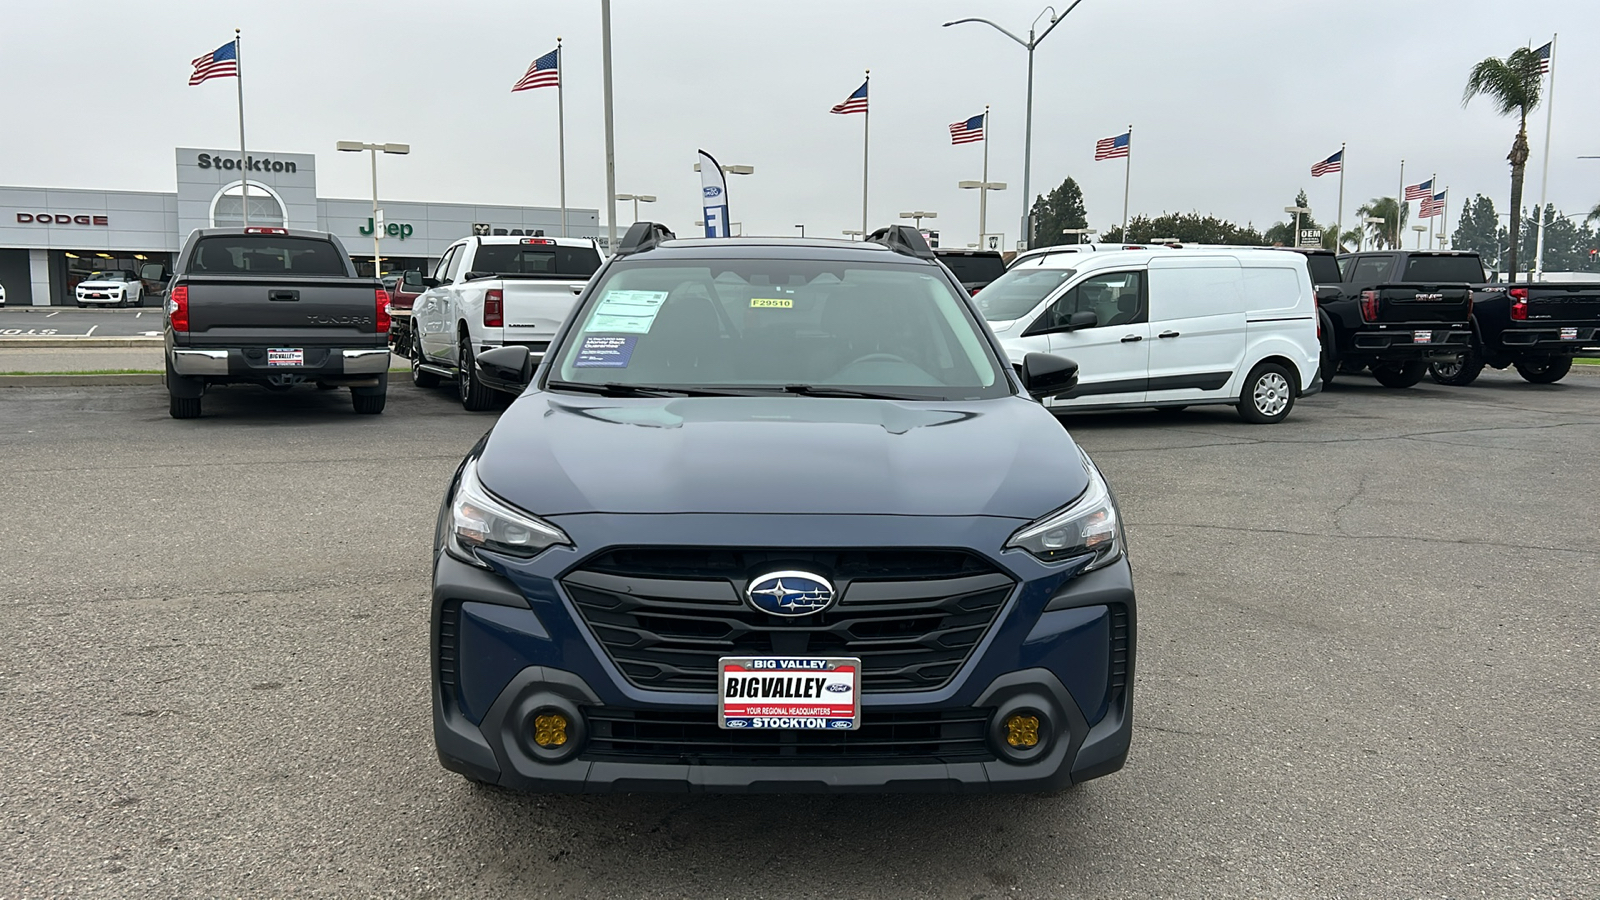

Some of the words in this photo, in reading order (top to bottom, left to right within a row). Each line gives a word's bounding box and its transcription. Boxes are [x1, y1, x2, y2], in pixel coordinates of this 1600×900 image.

[198, 153, 297, 173] Stockton
[17, 213, 108, 226] DODGE
[359, 217, 414, 240] Jep
[1301, 230, 1321, 238] OEM
[307, 315, 371, 324] TUNDRA
[754, 660, 776, 668] BIG
[780, 660, 827, 669] VALLEY
[726, 677, 827, 698] BIGVALLEY
[828, 684, 850, 692] Ford
[747, 707, 761, 715] YOUR
[762, 707, 788, 715] REGIONAL
[789, 708, 831, 716] HEADQUARTERS
[753, 718, 826, 728] STOCKTON
